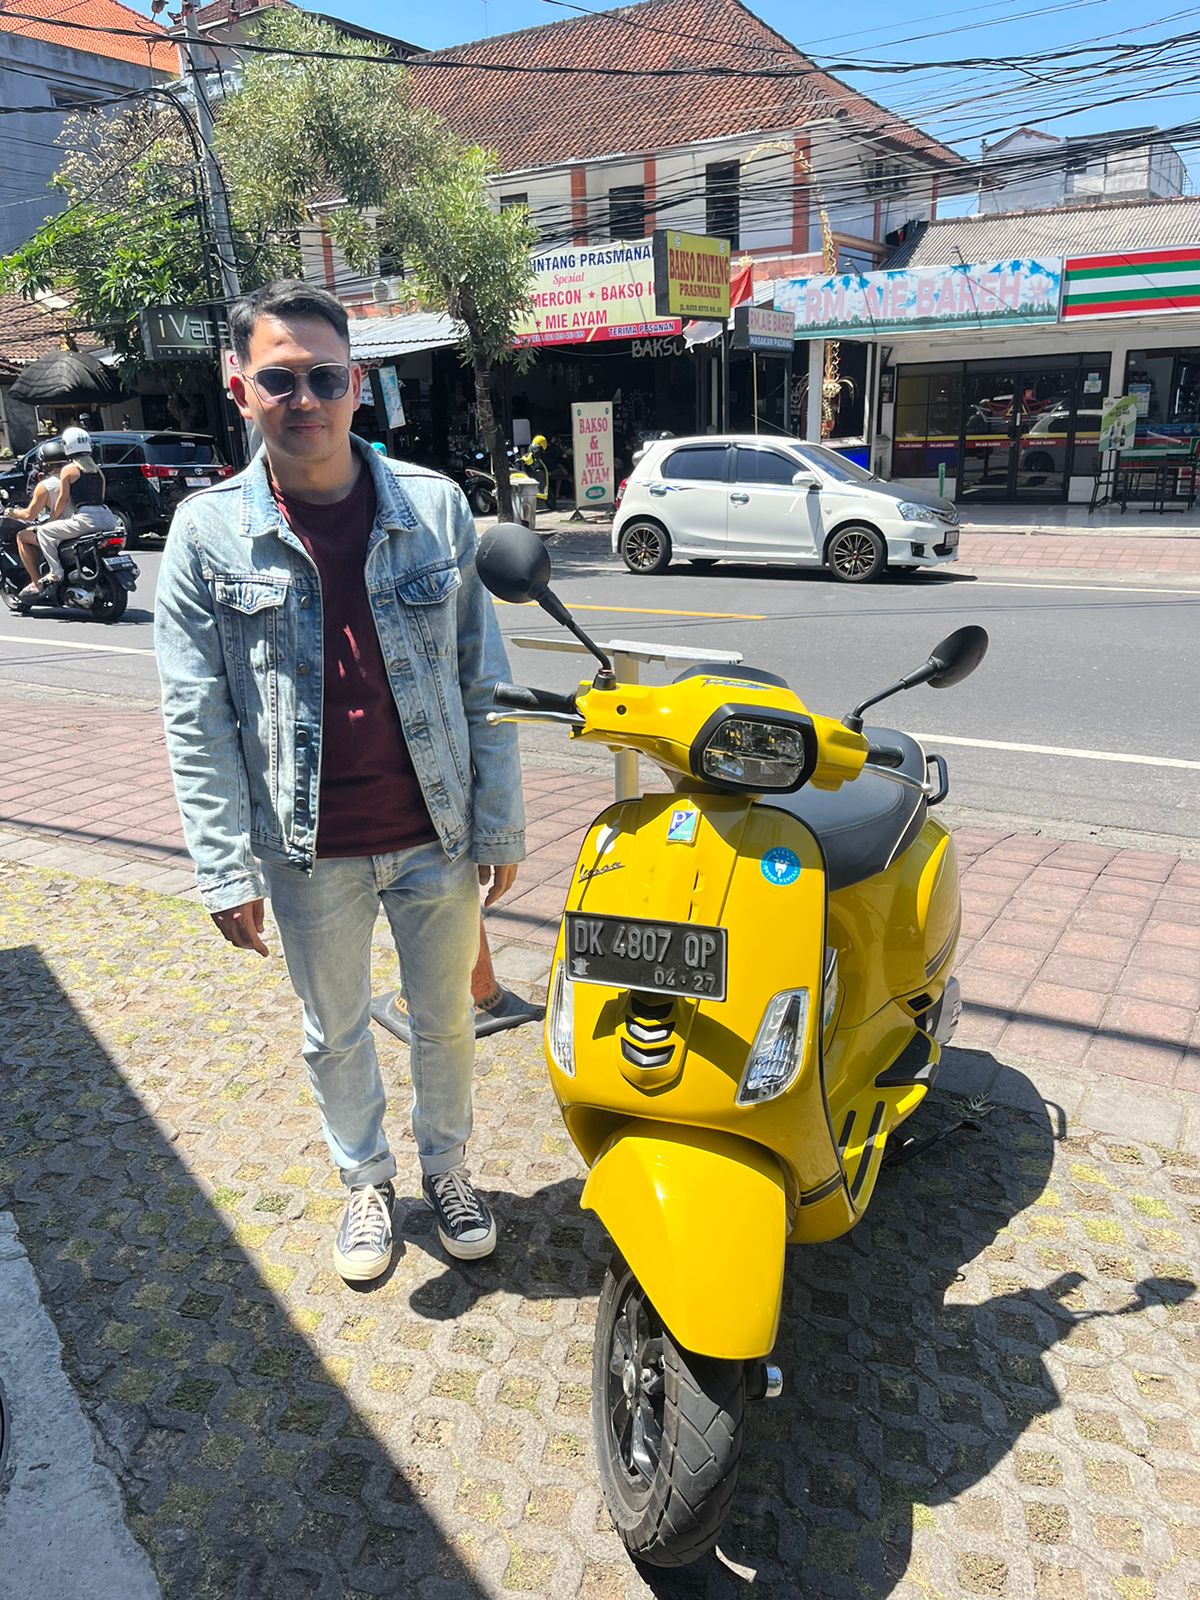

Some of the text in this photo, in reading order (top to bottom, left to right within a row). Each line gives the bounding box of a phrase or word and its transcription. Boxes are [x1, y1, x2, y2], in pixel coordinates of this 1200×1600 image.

[532, 245, 654, 273] INTANG PRASMANA
[669, 248, 729, 286] BAKSO BINTANG
[552, 271, 585, 287] Spesial
[601, 282, 644, 301] BAKSO
[679, 283, 721, 299] PRASMANAN
[862, 281, 909, 320] AIE
[916, 272, 1021, 317] BAREH
[545, 309, 608, 330] MIE AYAM
[608, 321, 675, 338] TERIMA PESANAN
[579, 417, 608, 434] BAKSO
[590, 435, 599, 450] &
[585, 452, 604, 468] MIE
[581, 467, 609, 486] AYAM
[573, 919, 717, 969] DK 4807 QP
